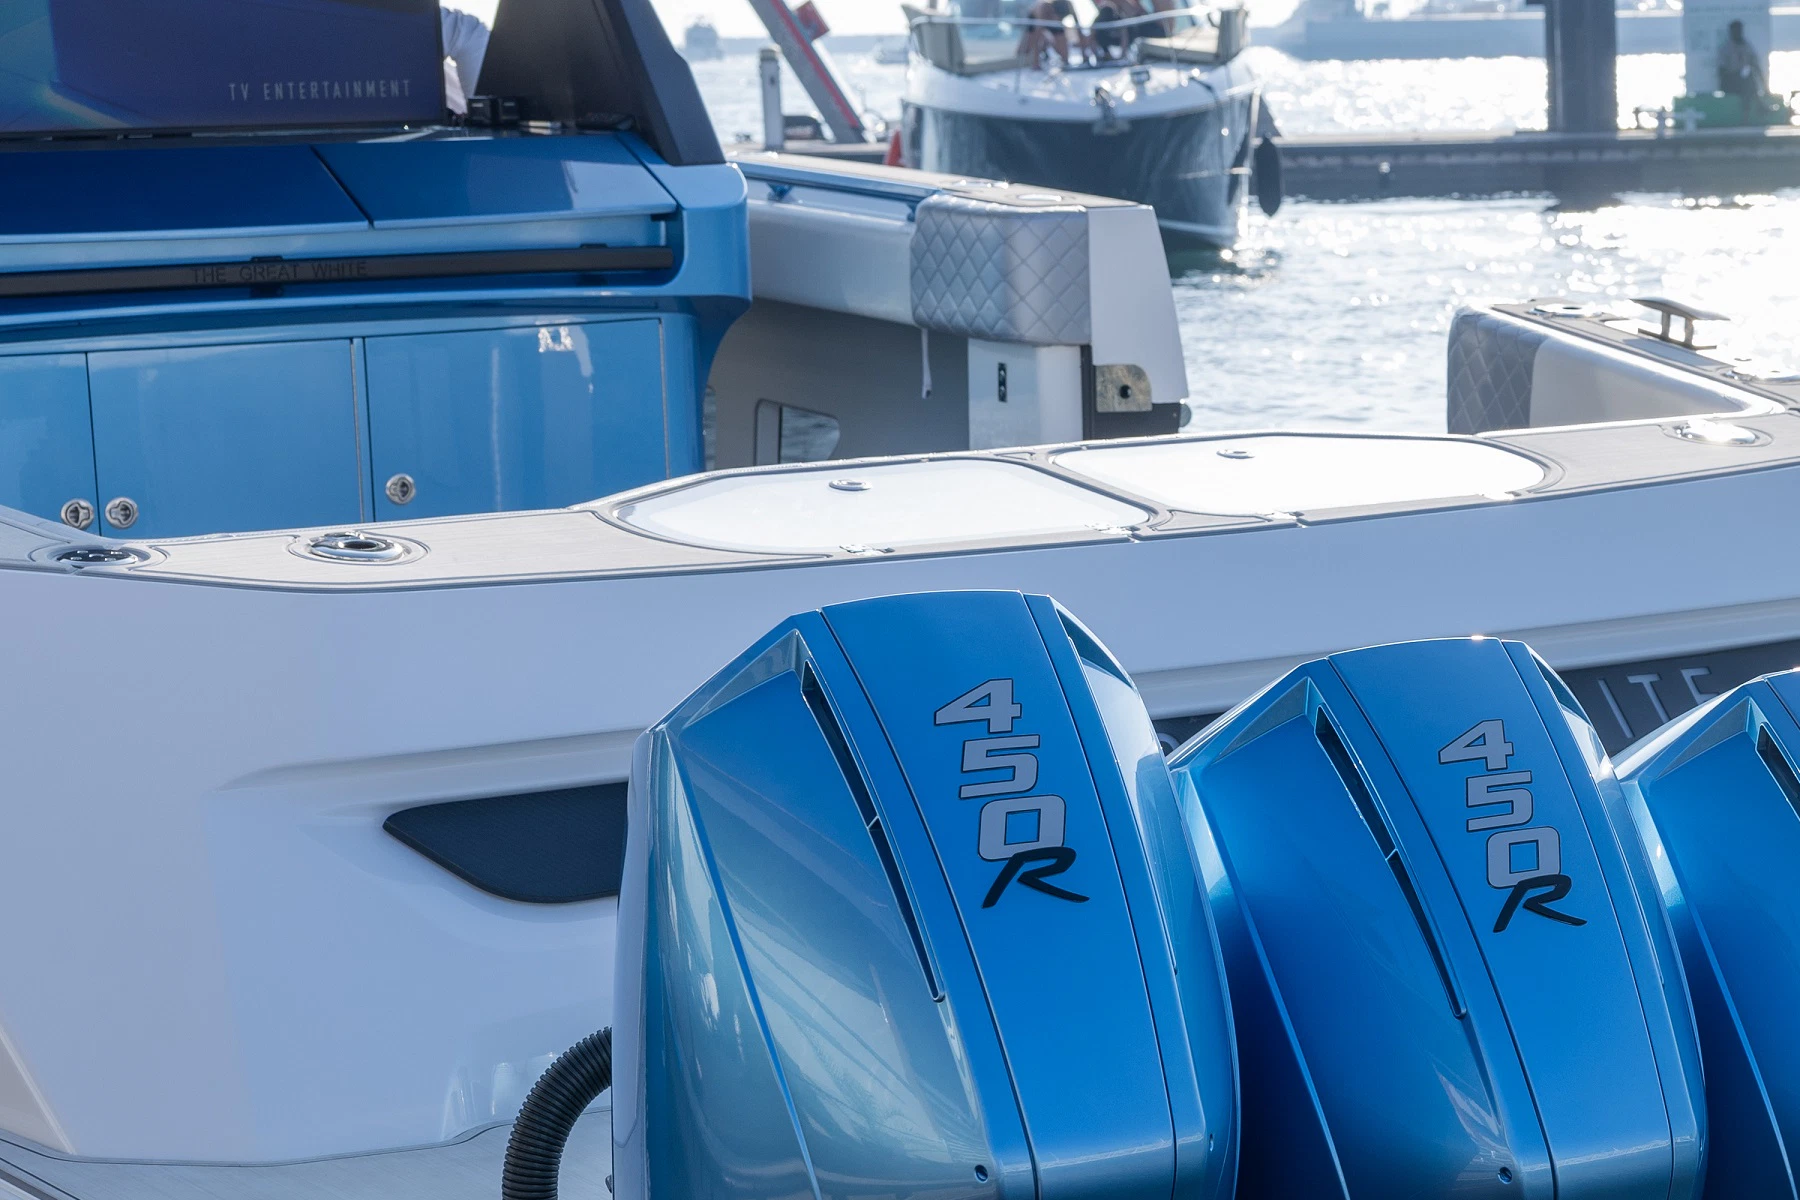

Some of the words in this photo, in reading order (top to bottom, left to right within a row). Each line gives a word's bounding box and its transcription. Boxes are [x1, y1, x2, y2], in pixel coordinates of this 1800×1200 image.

[229, 83, 249, 101] TV
[263, 79, 410, 101] ENTERTAINMENT
[192, 267, 226, 284] THE
[239, 263, 300, 282] GREAT
[311, 260, 370, 279] WHITE
